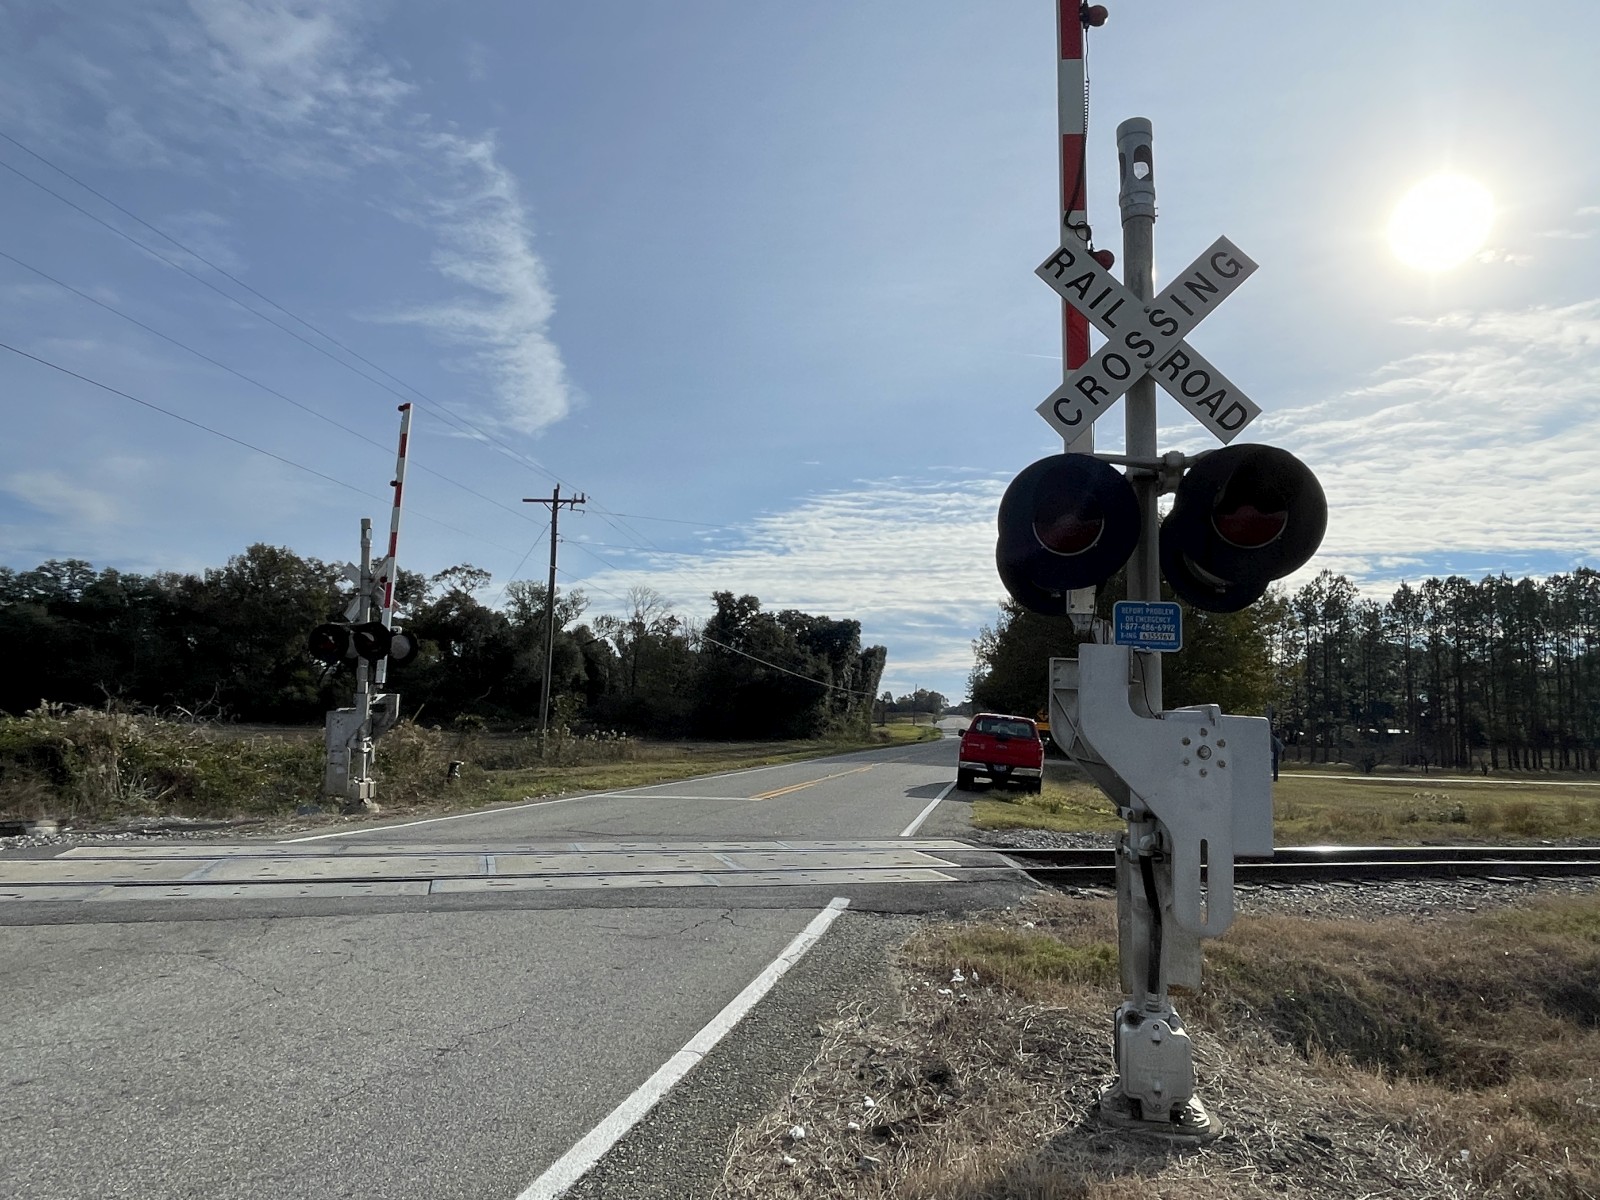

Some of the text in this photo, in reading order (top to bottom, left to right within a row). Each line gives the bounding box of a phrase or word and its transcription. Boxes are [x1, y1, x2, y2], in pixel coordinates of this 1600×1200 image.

[1044, 247, 1248, 431] RAIL ROAD
[1053, 251, 1244, 427] CROSSING
[1121, 607, 1174, 615] REPORT PROBLEM
